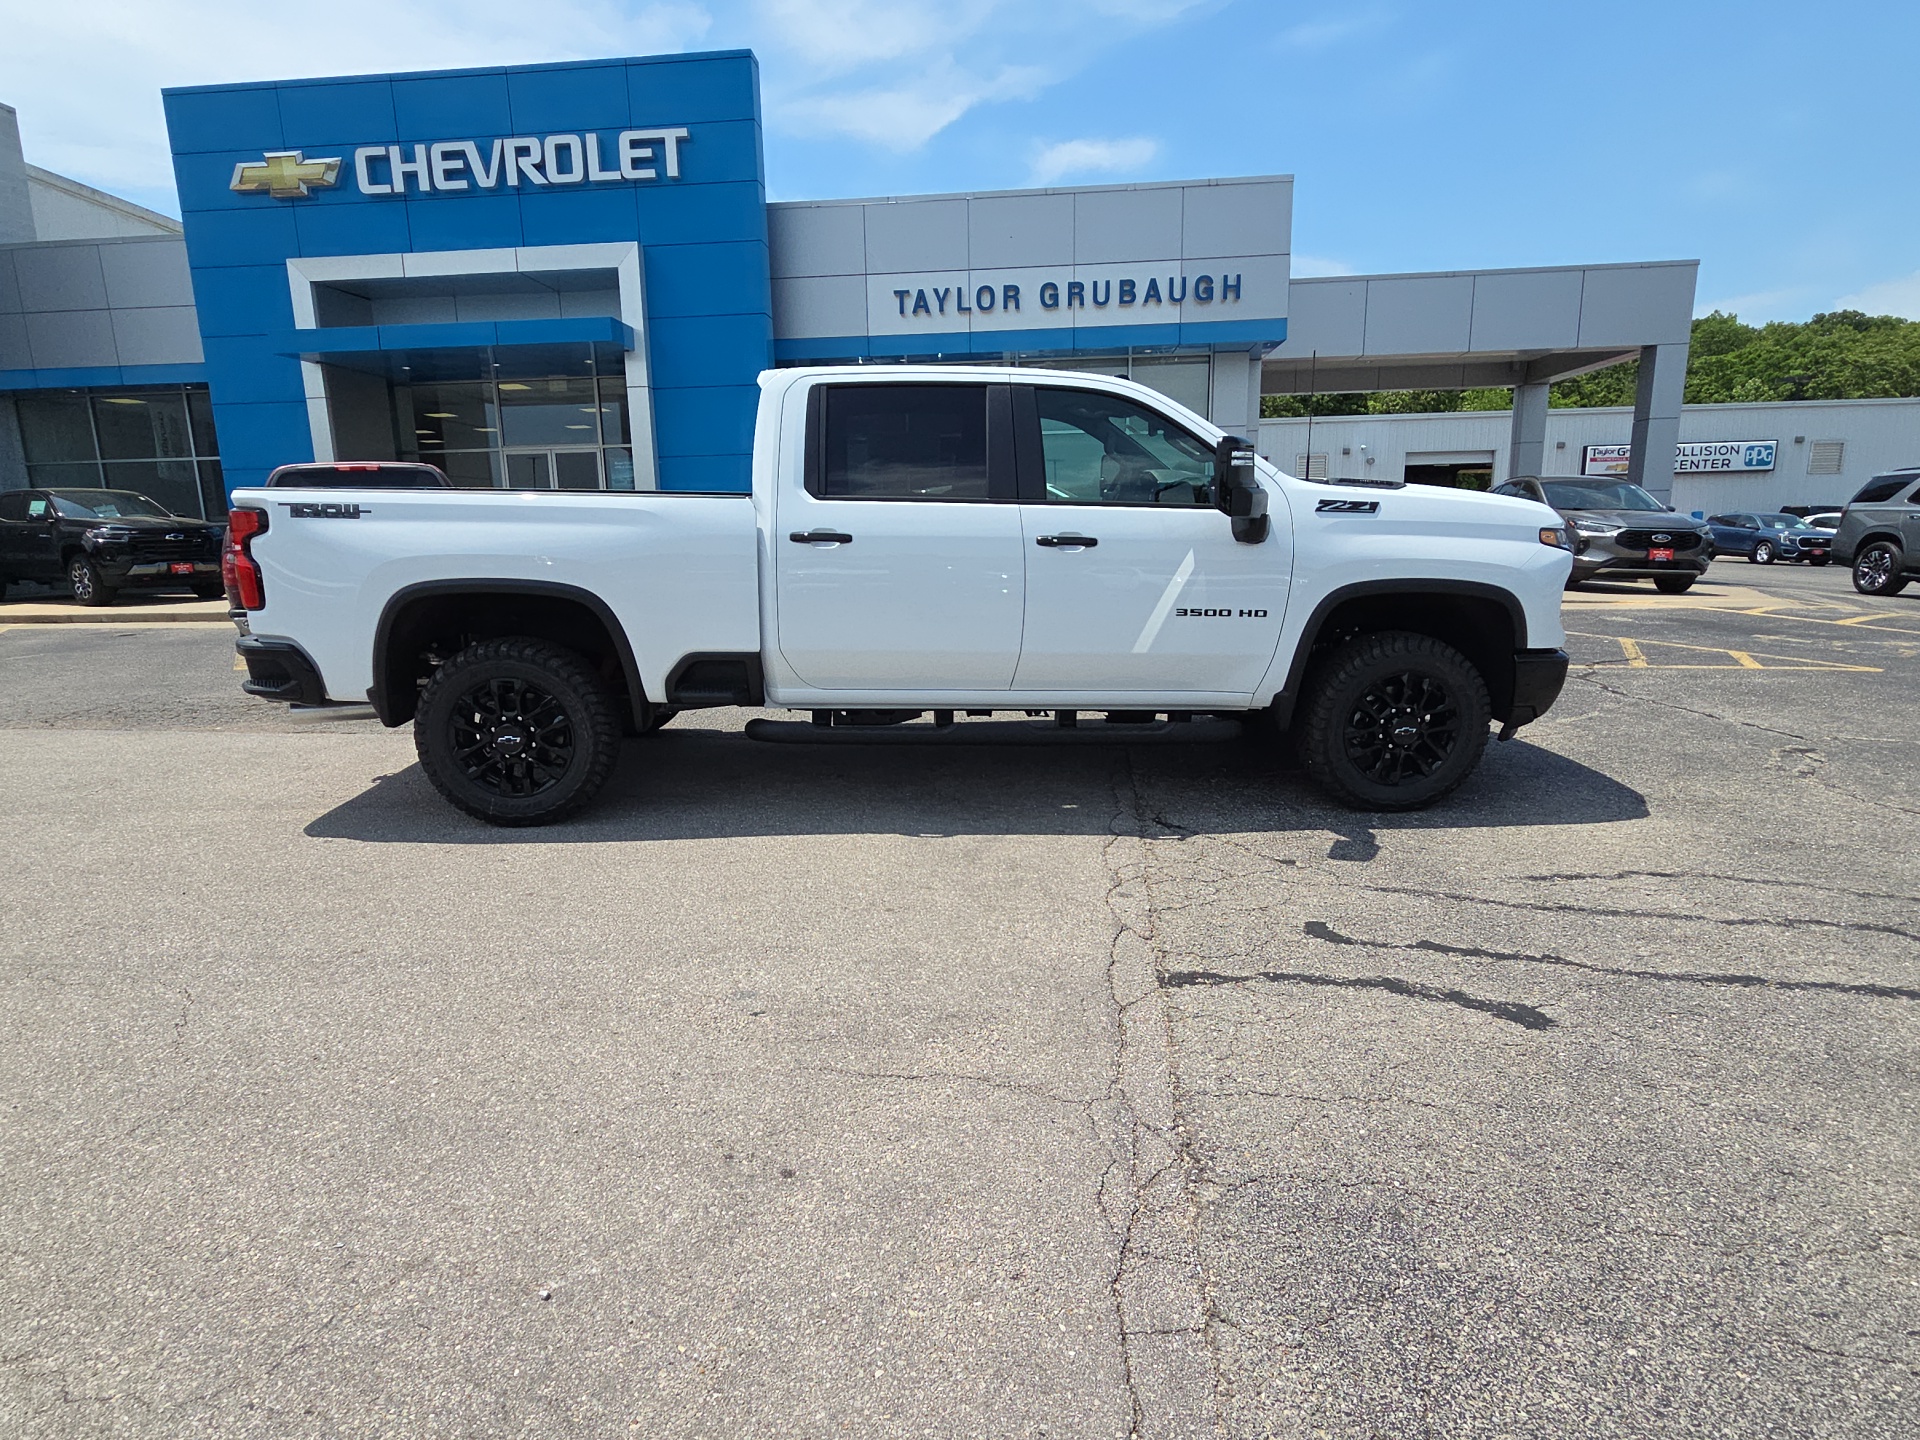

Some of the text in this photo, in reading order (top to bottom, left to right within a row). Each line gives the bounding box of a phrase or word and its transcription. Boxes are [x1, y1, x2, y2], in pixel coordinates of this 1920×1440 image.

[354, 127, 689, 195] CHEVROLET
[893, 273, 1243, 315] TAYLOR GRUBAUGH
[1590, 447, 1616, 457] Taylor
[1675, 445, 1740, 457] OLLISION
[1745, 446, 1773, 465] PPG
[1175, 608, 1268, 618] 3500 HD
